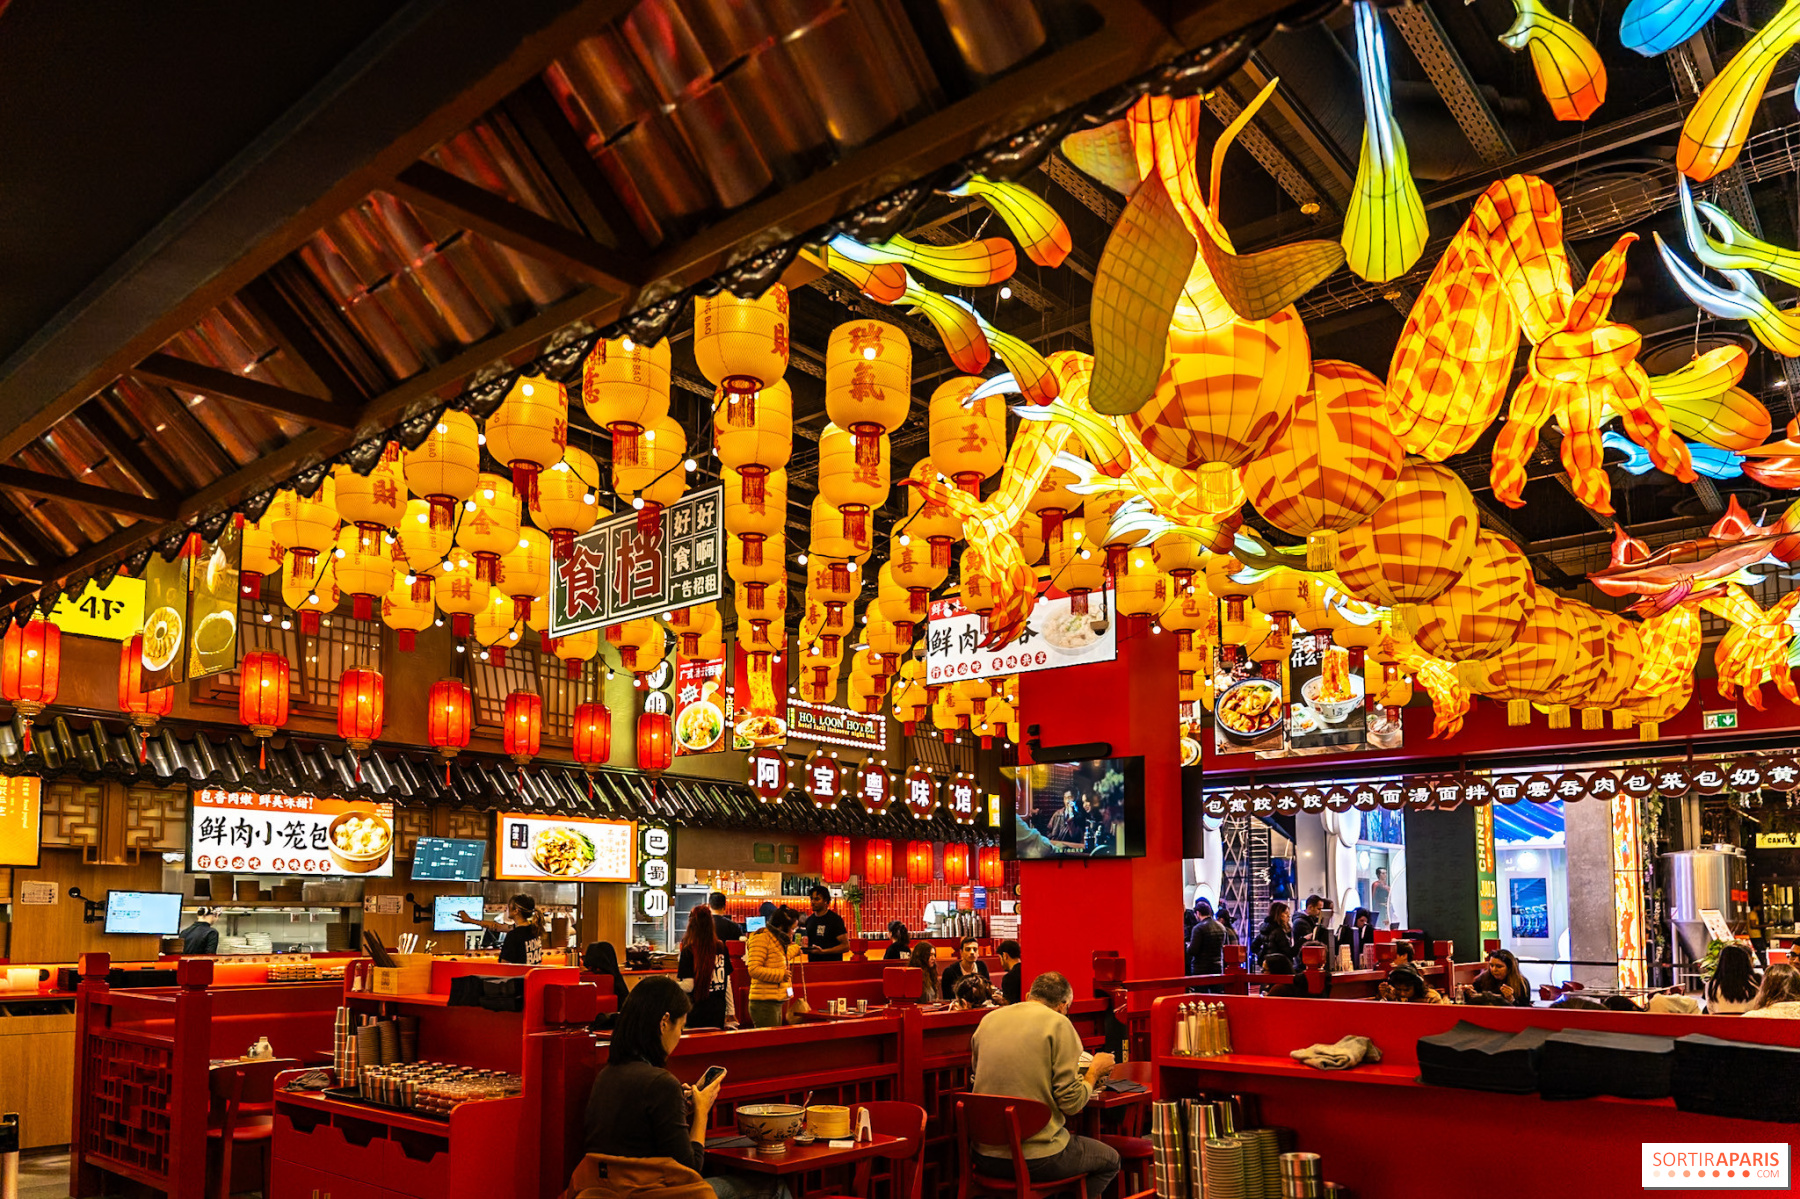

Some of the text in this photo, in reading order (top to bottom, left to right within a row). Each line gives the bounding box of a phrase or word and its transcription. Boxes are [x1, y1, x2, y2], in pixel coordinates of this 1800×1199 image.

[674, 501, 715, 537] 好好
[673, 538, 715, 573] 食啊
[670, 573, 717, 602] 广告招租
[819, 715, 844, 729] LOON
[846, 720, 876, 734] HOTEL
[757, 756, 972, 813] 阿宝粤味馆
[198, 815, 329, 851] 鲜肉小笼包
[646, 835, 665, 912] 巴蜀川
